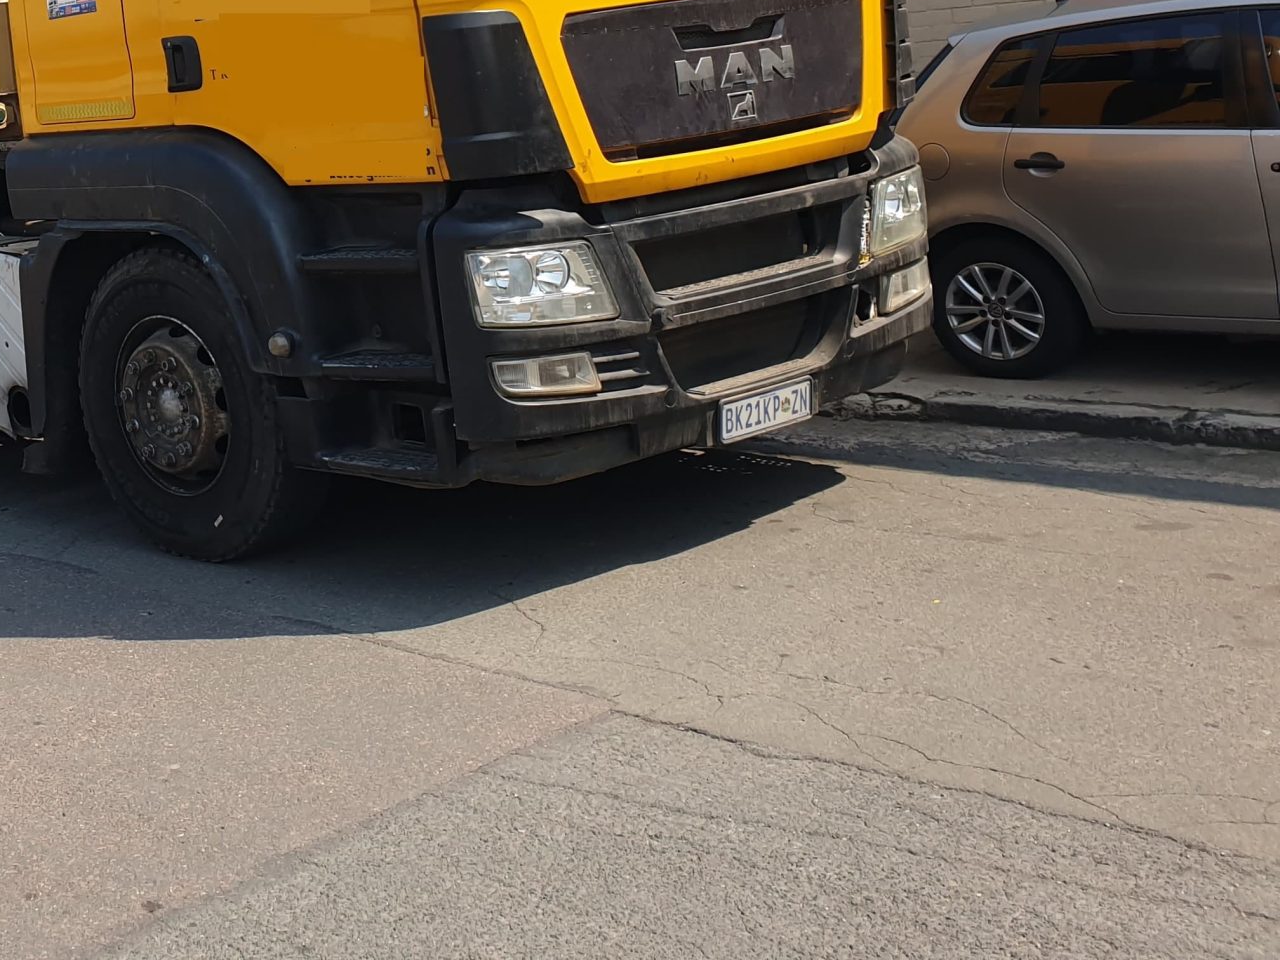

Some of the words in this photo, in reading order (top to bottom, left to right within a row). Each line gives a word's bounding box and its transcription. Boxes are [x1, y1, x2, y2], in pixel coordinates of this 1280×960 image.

[674, 44, 795, 96] MAN
[725, 395, 781, 434] BK21KP
[791, 386, 808, 415] ZN
